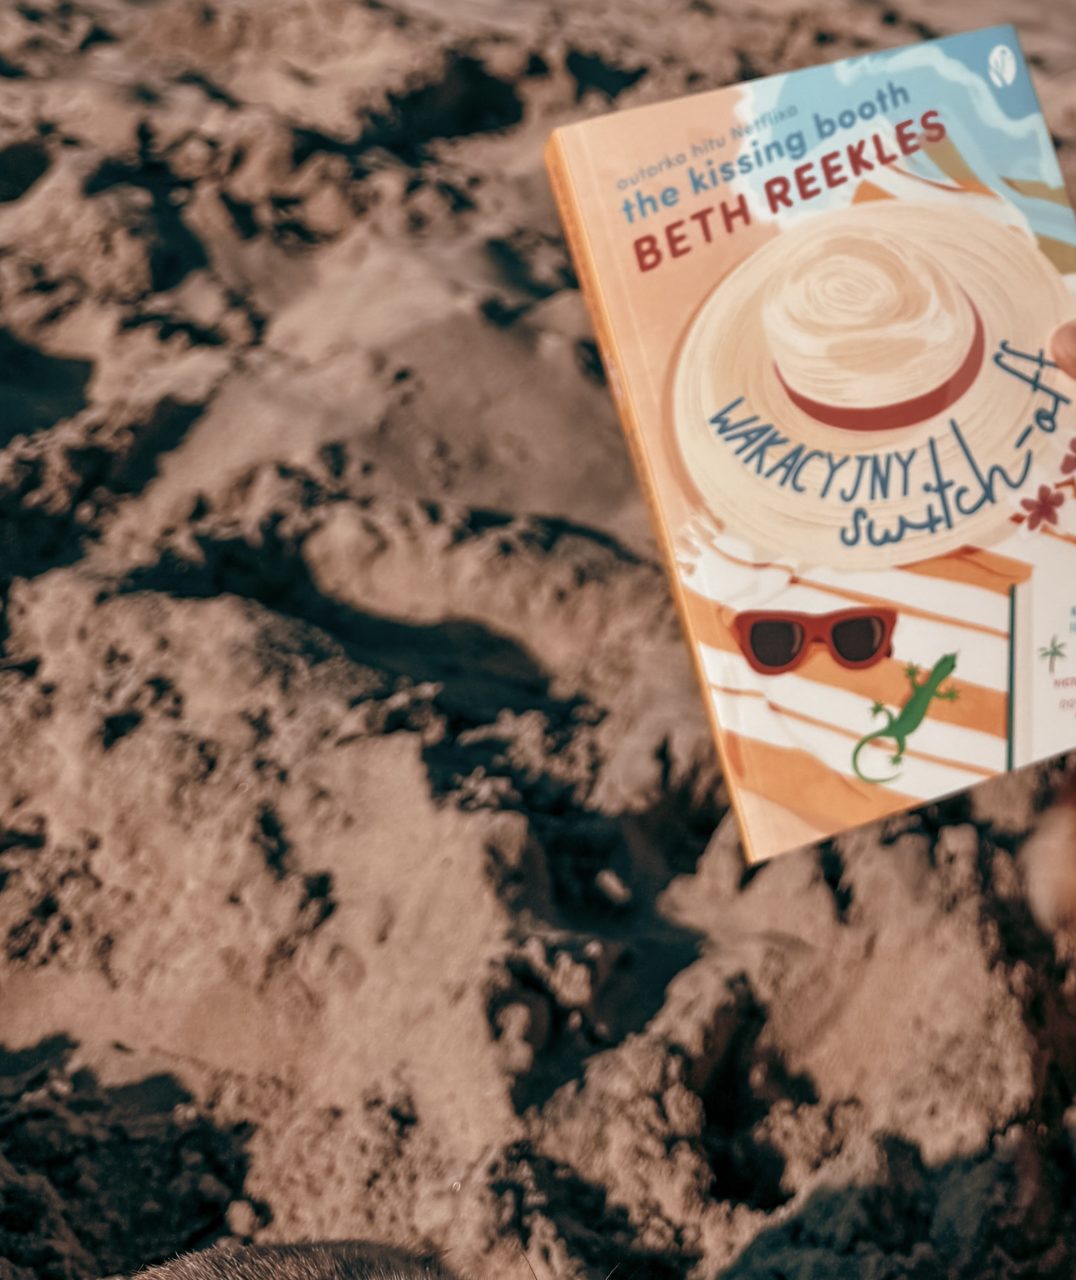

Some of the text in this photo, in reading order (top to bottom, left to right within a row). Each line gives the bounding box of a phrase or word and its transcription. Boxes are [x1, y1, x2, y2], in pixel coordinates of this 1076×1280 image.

[616, 151, 687, 191] autorka
[690, 136, 726, 158] hitu
[621, 81, 911, 225] the kissing booth
[632, 110, 948, 273] BETH REEKLES
[709, 396, 917, 503] WAKACYJNY
